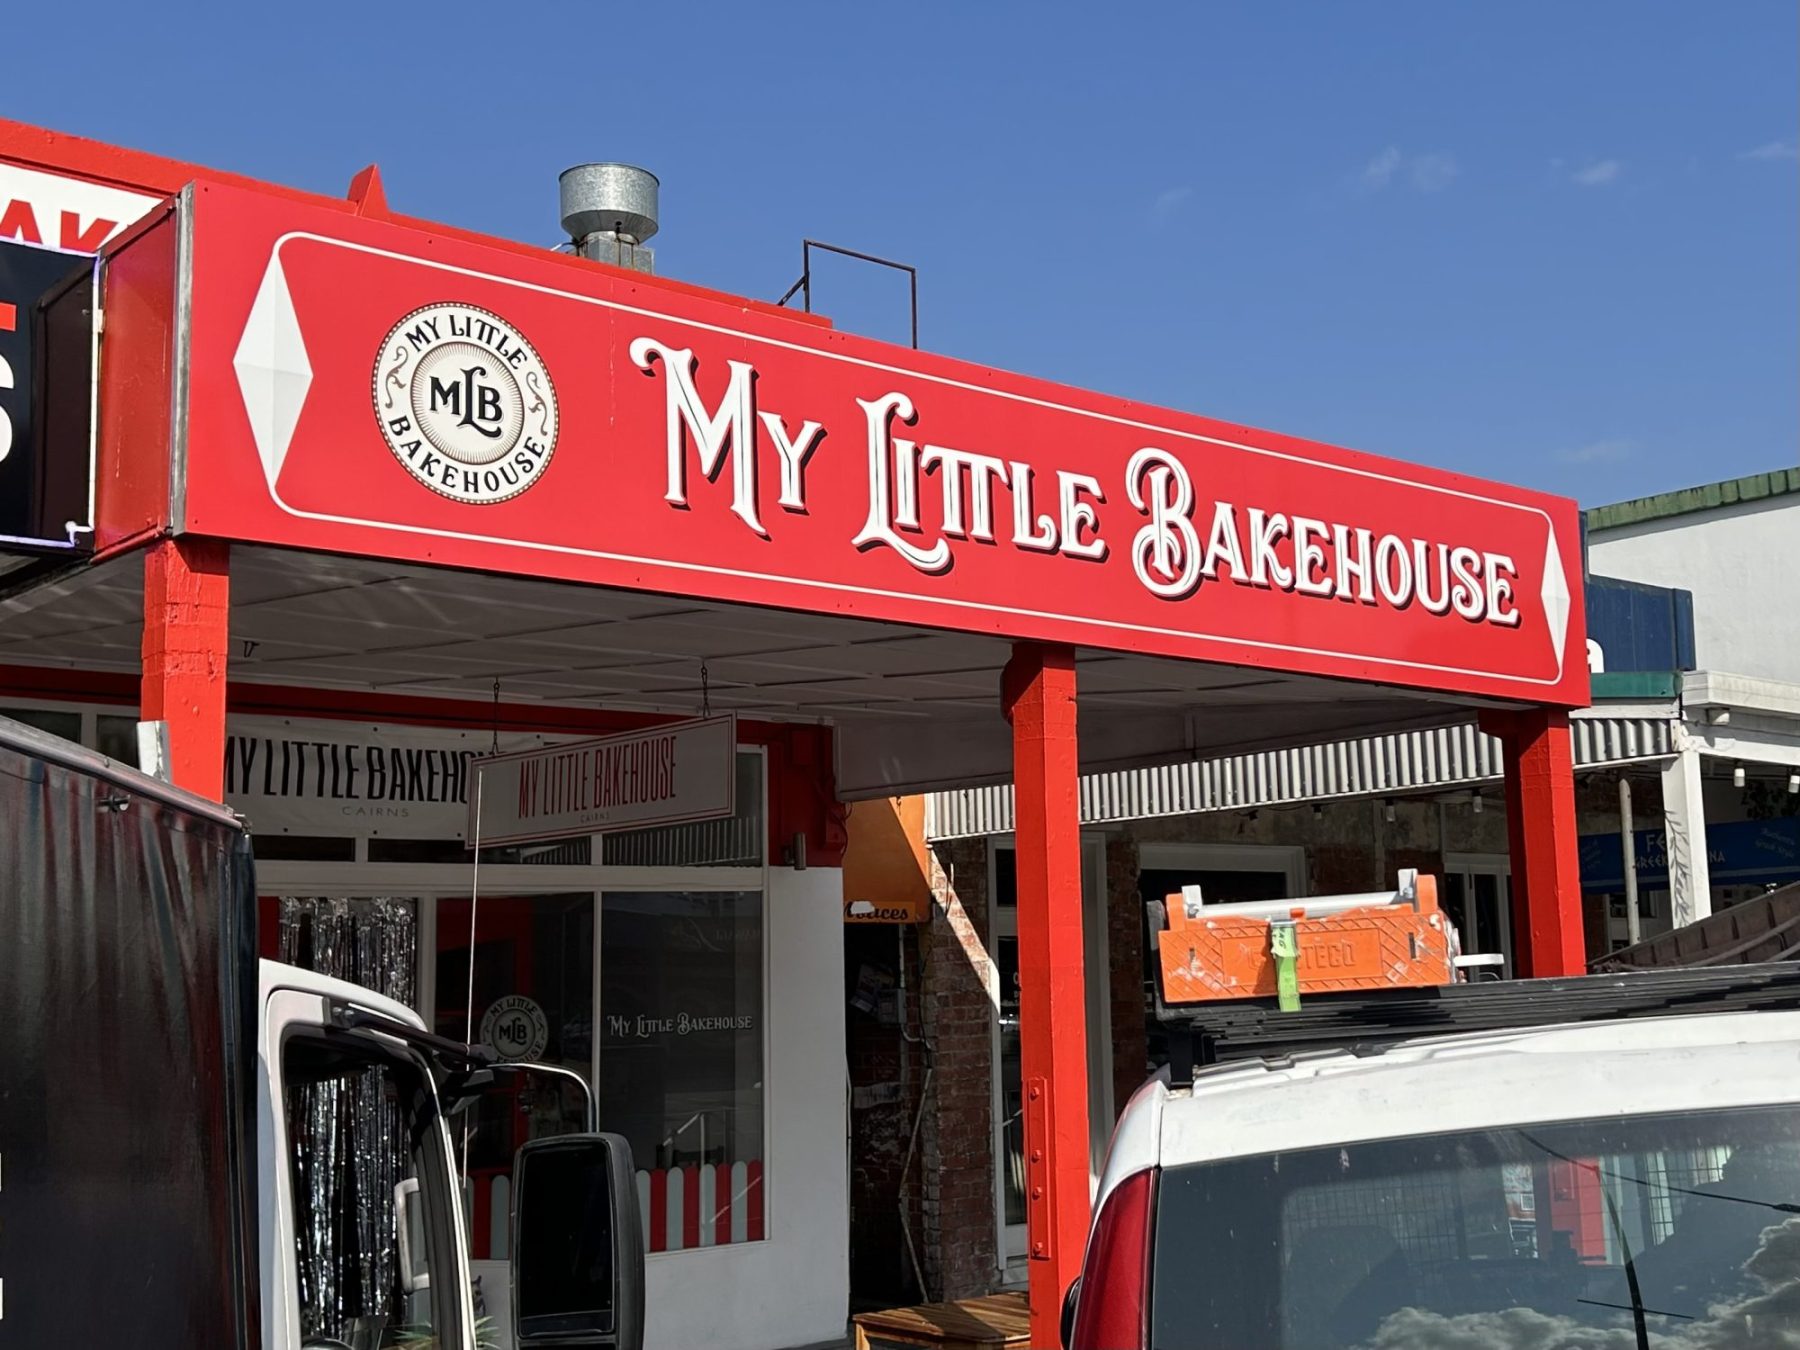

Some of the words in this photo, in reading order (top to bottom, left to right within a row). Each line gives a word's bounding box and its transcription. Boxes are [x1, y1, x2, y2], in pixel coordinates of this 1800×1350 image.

[405, 316, 441, 352] MY
[449, 314, 528, 370] LITTLE
[430, 366, 504, 438] MLB
[388, 415, 546, 494] BAKEHOUSE
[263, 739, 360, 799] LITTLE
[518, 759, 539, 819] MY
[543, 751, 589, 816] LITTLE
[593, 736, 677, 809] BAKEHOUSE
[342, 806, 409, 818] CAIRNS
[490, 1001, 504, 1017] MY
[507, 997, 538, 1015] LITTLE
